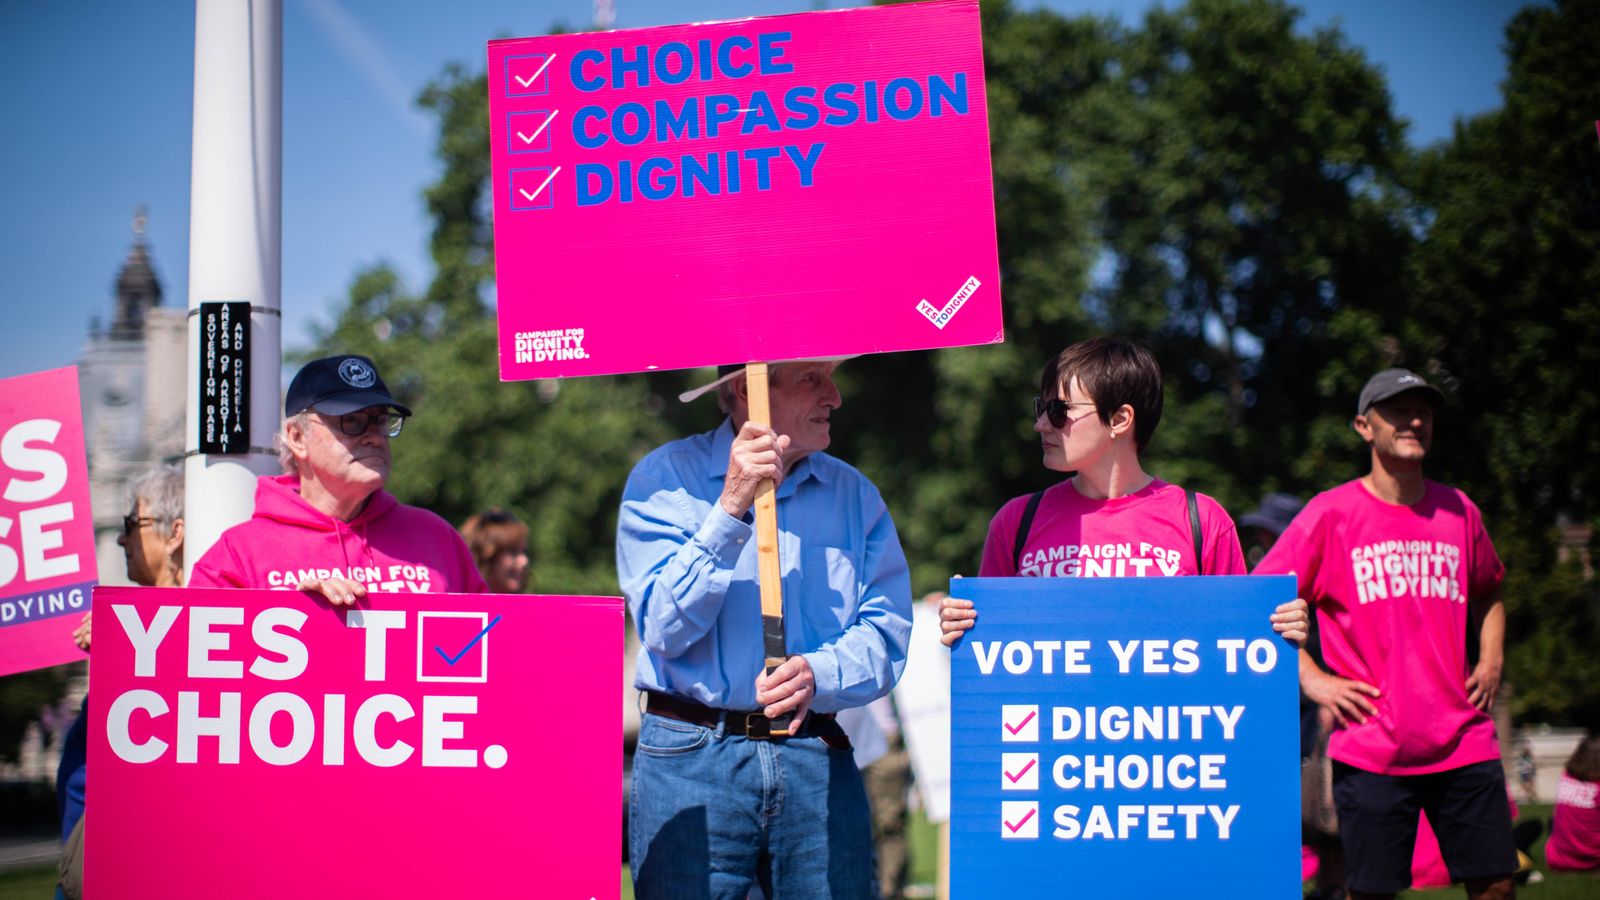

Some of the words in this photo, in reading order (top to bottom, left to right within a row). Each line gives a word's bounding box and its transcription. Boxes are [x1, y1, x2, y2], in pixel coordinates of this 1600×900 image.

[569, 31, 794, 92] CHOICE
[571, 72, 970, 149] COMPASSION
[575, 142, 826, 207] DIGNITY
[921, 303, 938, 320] YES
[945, 279, 976, 315] DIGNITY
[220, 303, 230, 349] AREAS
[234, 322, 243, 350] AND
[515, 329, 563, 339] CAMPAIGN
[566, 327, 584, 336] FOR
[515, 335, 584, 352] DIGNITY
[207, 313, 216, 397] SOVEREIGN
[220, 355, 230, 374] OF
[516, 351, 533, 363] IN
[535, 347, 590, 362] DYING.
[207, 405, 215, 443] BASE
[220, 379, 229, 453] AKROTIRI
[0, 501, 80, 587] E
[1021, 542, 1131, 567] CAMPAIGN
[1139, 542, 1182, 566] FOR
[1351, 540, 1432, 561] CAMPAIGN
[1435, 541, 1460, 558] FOR
[388, 565, 430, 581] FOR
[1353, 553, 1460, 584] DIGNITY
[1, 589, 83, 623] DYING
[1357, 577, 1388, 605] IN
[1390, 575, 1465, 605] DYING.
[110, 604, 309, 681] YES
[972, 640, 1091, 675] VOTE
[1107, 639, 1200, 674] YES
[1217, 639, 1278, 673] TO
[106, 690, 508, 769] CHOICE.
[1052, 705, 1245, 741] DIGNITY
[1052, 754, 1226, 789] CHOICE
[1052, 805, 1241, 840] SAFETY
